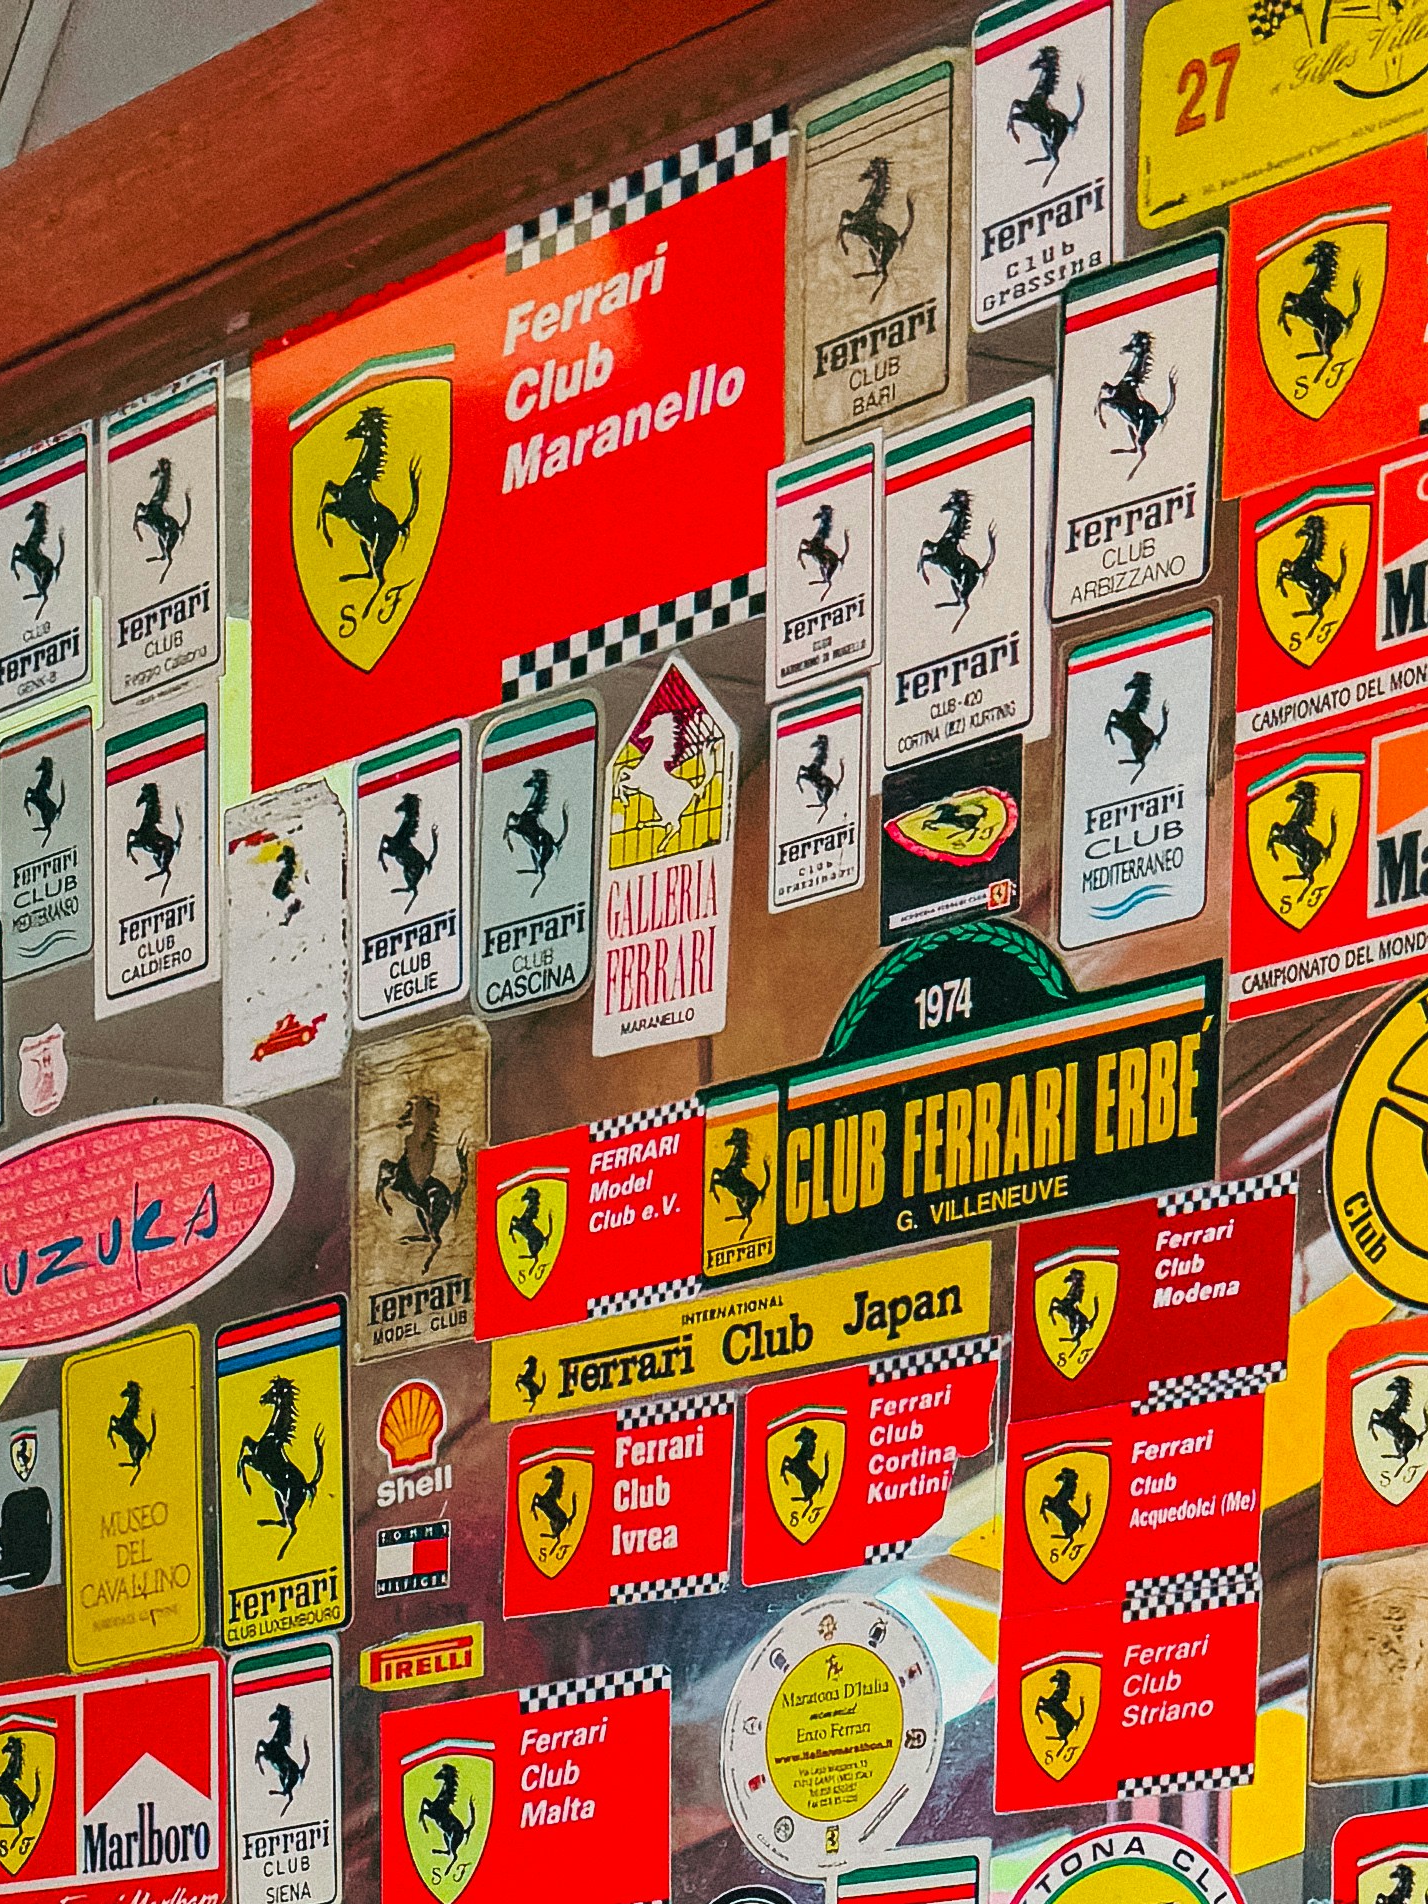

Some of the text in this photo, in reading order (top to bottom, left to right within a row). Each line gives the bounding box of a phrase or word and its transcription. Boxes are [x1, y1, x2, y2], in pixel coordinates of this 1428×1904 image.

[1174, 45, 1241, 137] 27
[503, 241, 669, 357] Ferrari
[814, 301, 938, 377] Ferrari
[503, 345, 613, 424] Club
[849, 357, 900, 389] CLUB
[852, 383, 897, 414] BARI
[503, 365, 746, 495] Maranello
[1066, 482, 1196, 553] Ferrari
[1102, 536, 1156, 569] CLUB
[1070, 553, 1186, 605] ARBIZZANO
[1251, 686, 1350, 733] CAMPIONATO
[1356, 677, 1384, 703] DEL
[1084, 784, 1184, 834] Ferrari
[1084, 819, 1183, 861] CLUB
[1083, 848, 1184, 894] MEDITERRANEO
[119, 897, 195, 944] Ferrari
[606, 858, 719, 939] GALLERIA
[121, 947, 191, 983] CALDIERO
[138, 934, 175, 958] CLUB
[604, 926, 716, 1016] FERRARI
[914, 978, 973, 1029] 1974
[786, 1109, 885, 1225] CLUB
[903, 1068, 1078, 1197] FERRARI
[896, 1176, 1069, 1231] G. VILLENEUVE
[1344, 1191, 1388, 1266] Club
[681, 1295, 783, 1326] INTERNATIONAL
[558, 1282, 963, 1398] Ferrari Club Japan
[377, 1464, 453, 1508] Shell
[101, 1501, 168, 1534] MUSEO
[117, 1539, 152, 1568] DEL
[377, 1634, 471, 1686] PIRELLI
[520, 1719, 607, 1756] Ferrari
[520, 1761, 580, 1792] Club
[520, 1796, 596, 1829] Malta
[83, 1803, 210, 1875] Marlboro
